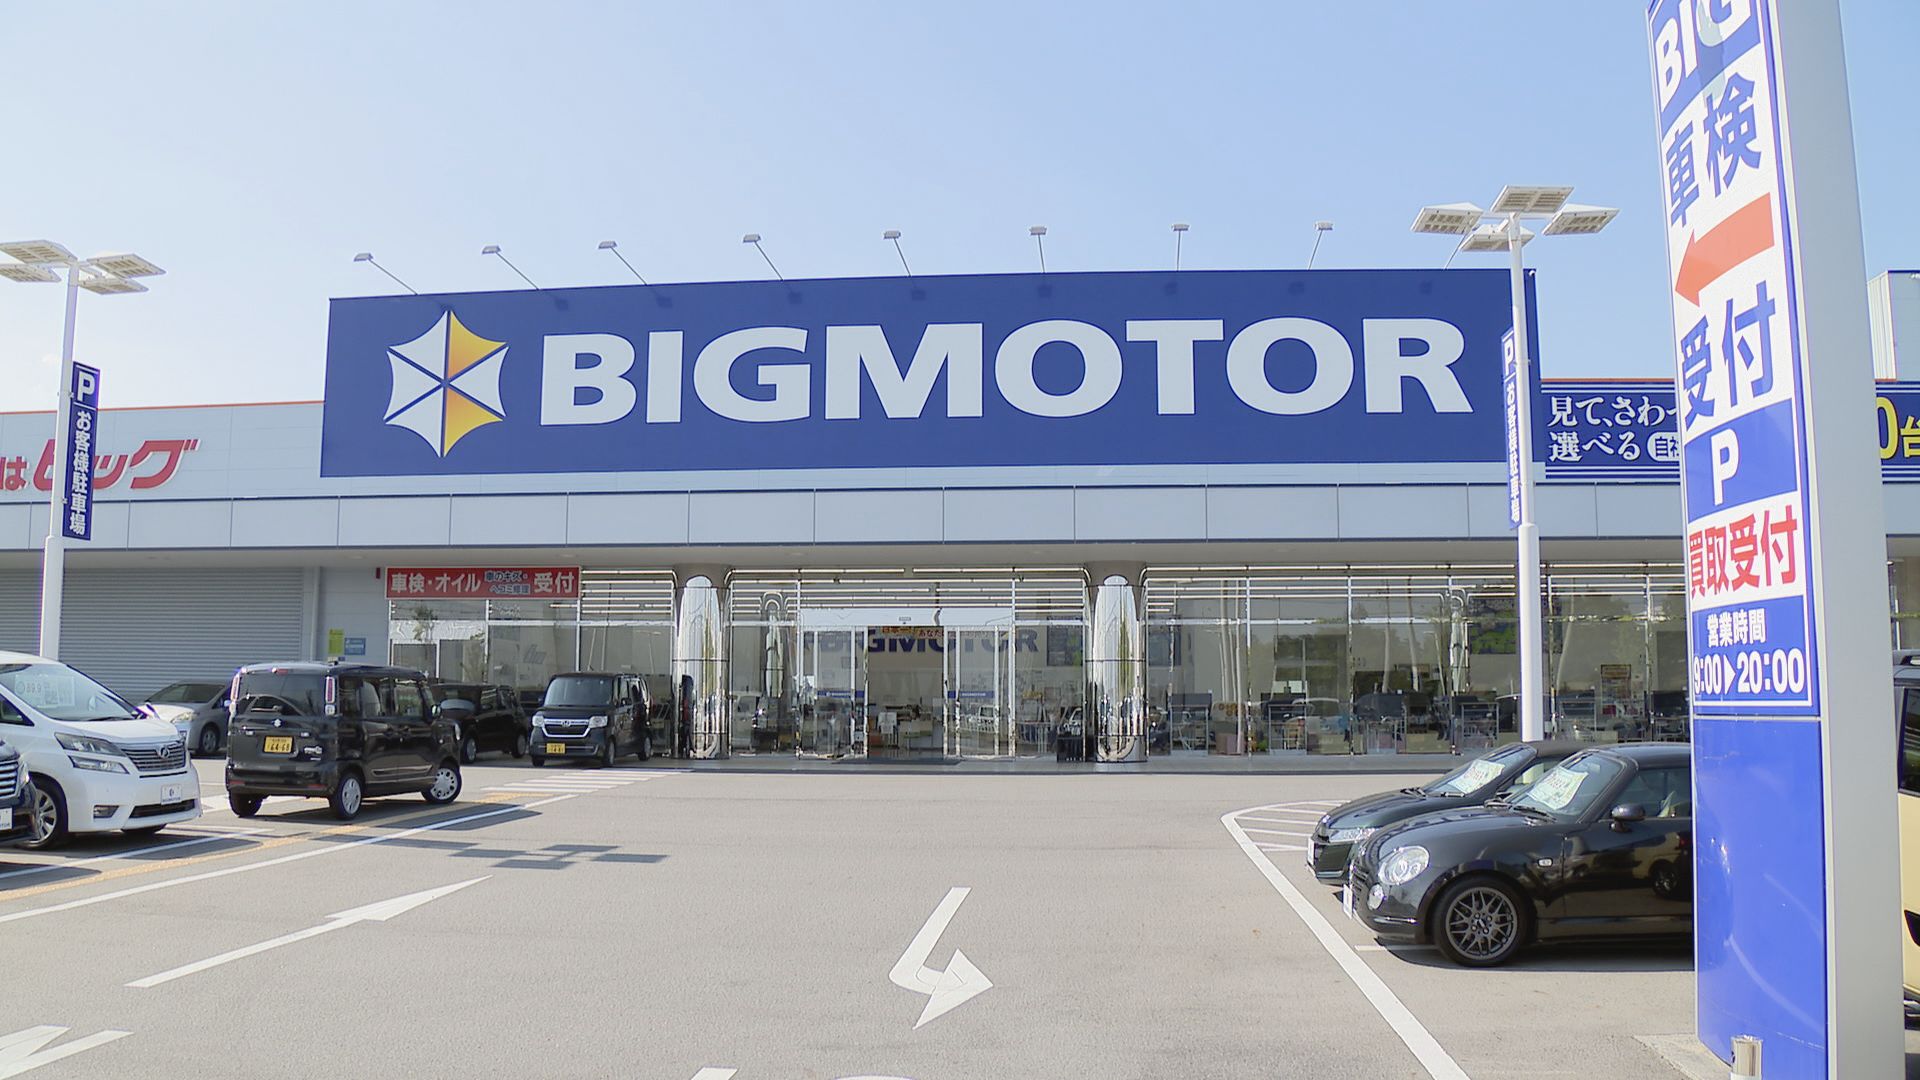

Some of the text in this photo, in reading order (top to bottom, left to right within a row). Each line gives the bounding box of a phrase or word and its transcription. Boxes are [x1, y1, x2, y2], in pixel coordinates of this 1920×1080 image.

[1656, 0, 1751, 112] BIG
[1666, 72, 1761, 227] 車検
[77, 371, 96, 402] P
[540, 316, 1474, 427] BIGMOTOR
[1505, 338, 1514, 373] P
[1680, 280, 1776, 430] 受付
[70, 411, 92, 536] お客様駐車場
[1548, 431, 1642, 462] 選べる
[1710, 428, 1740, 506] P
[534, 572, 575, 594] 受付
[1689, 504, 1799, 599] 買取受付
[1706, 607, 1767, 648] 営業時間
